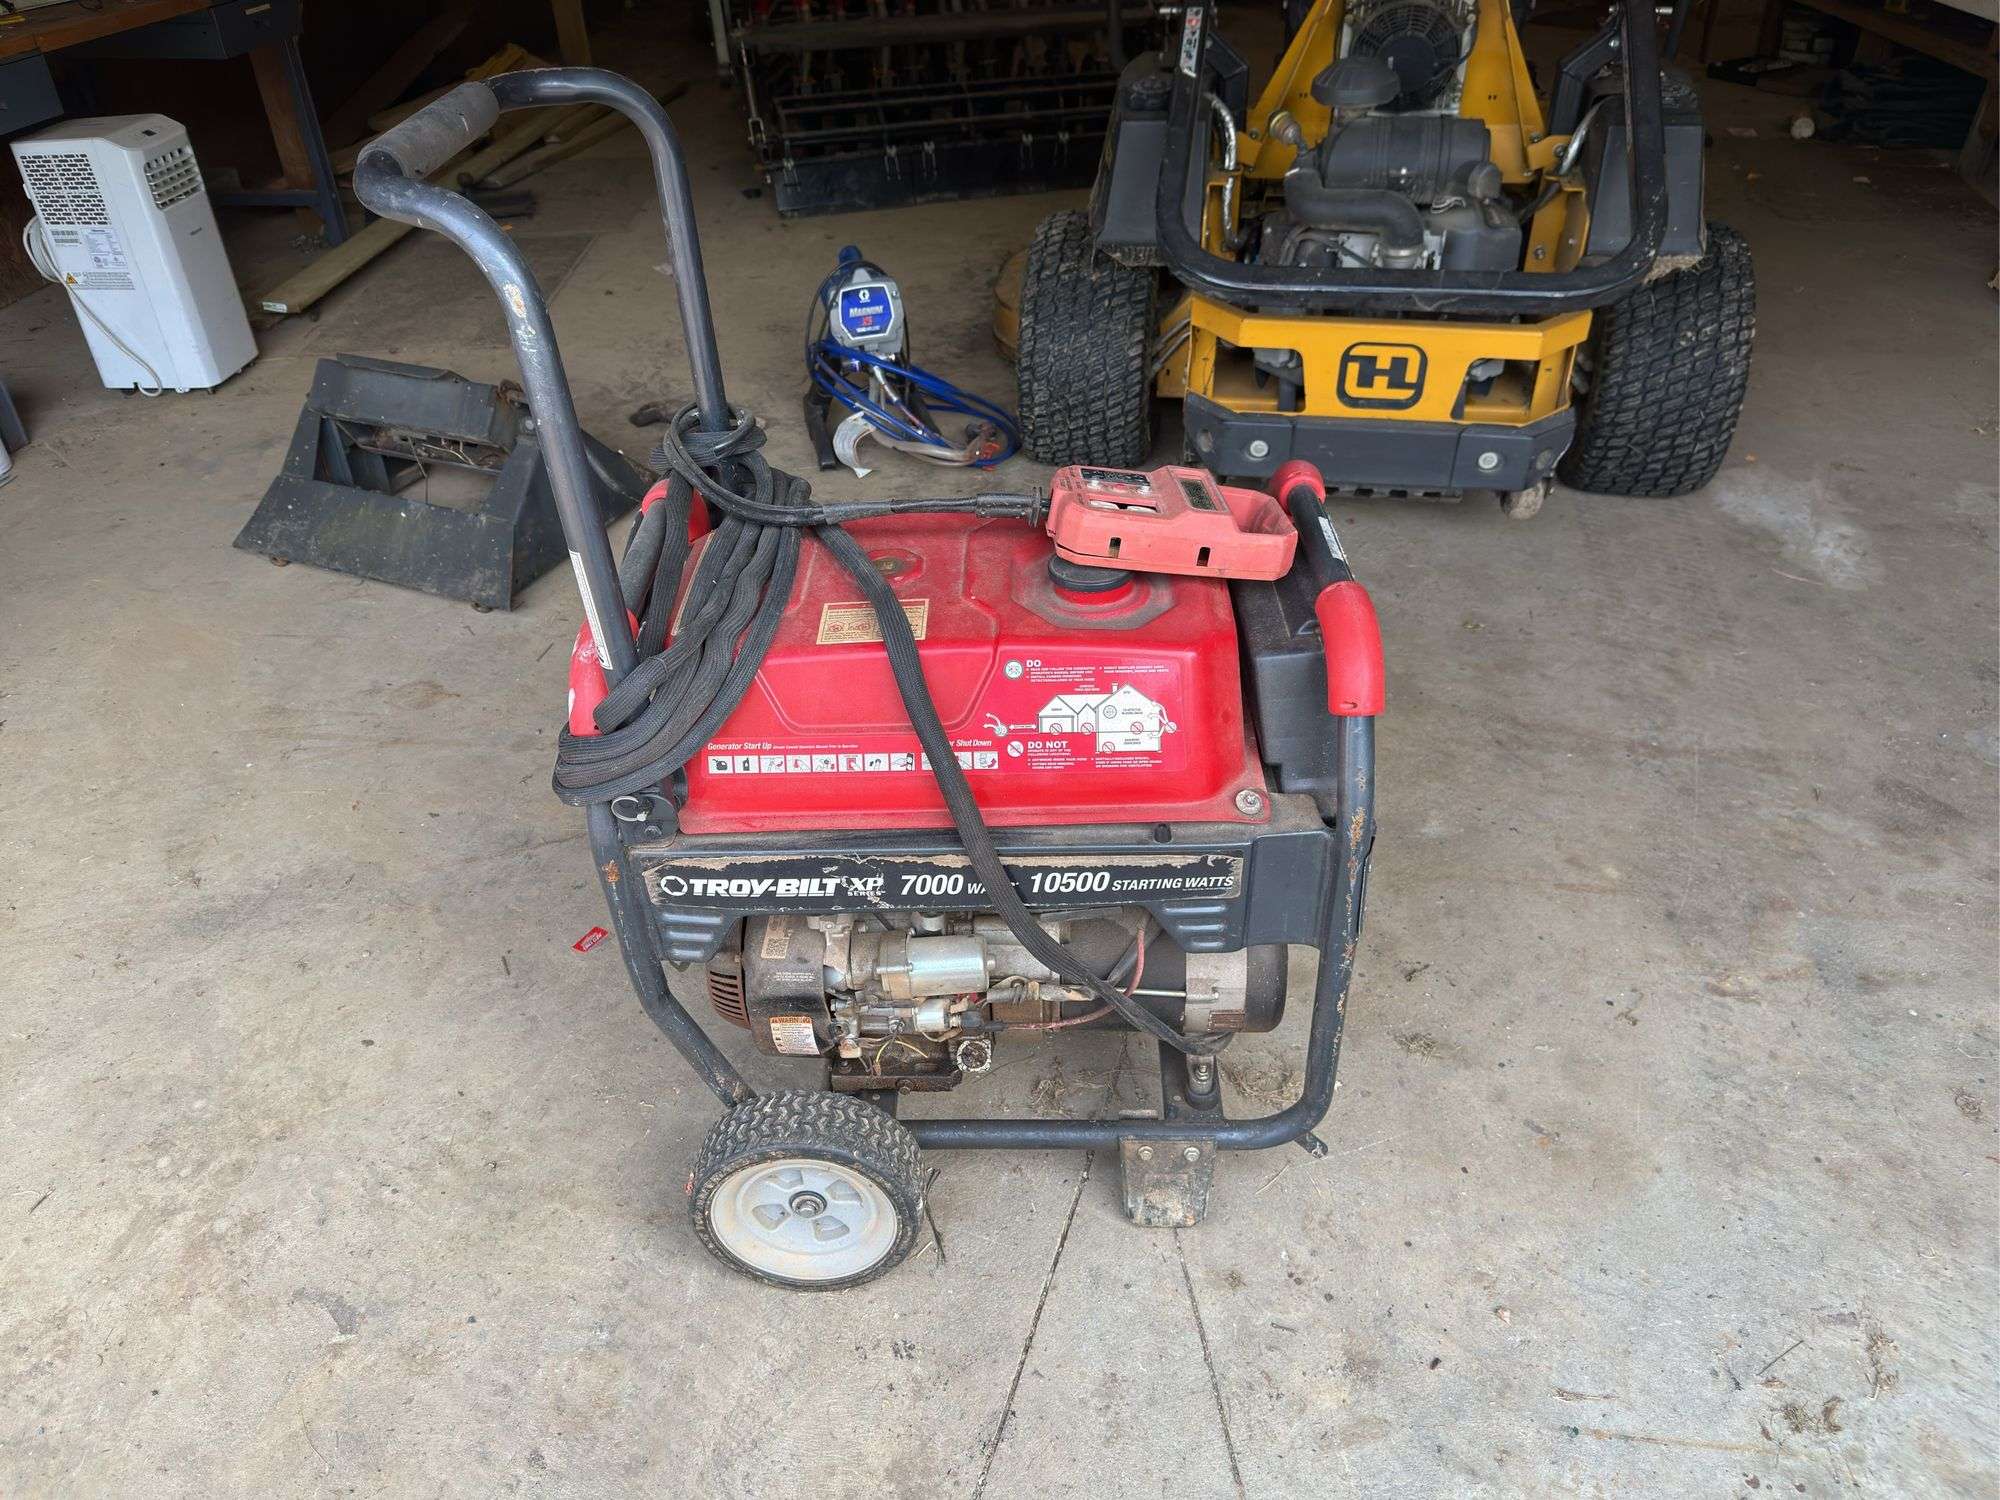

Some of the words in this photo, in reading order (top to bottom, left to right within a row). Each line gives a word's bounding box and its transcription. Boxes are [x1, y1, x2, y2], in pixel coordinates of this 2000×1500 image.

[1026, 660, 1041, 668] DO
[743, 742, 761, 750] Start
[762, 742, 772, 751] Up
[956, 739, 972, 747] Shut
[973, 739, 992, 747] Down
[1028, 741, 1047, 749] DO
[1049, 740, 1068, 749] NOT
[689, 878, 841, 897] TROY-BILT
[850, 877, 884, 891] XP
[900, 874, 964, 896] 7000
[1030, 871, 1110, 893] 10500
[1112, 877, 1182, 891] STARTING
[1185, 876, 1235, 888] WATTS
